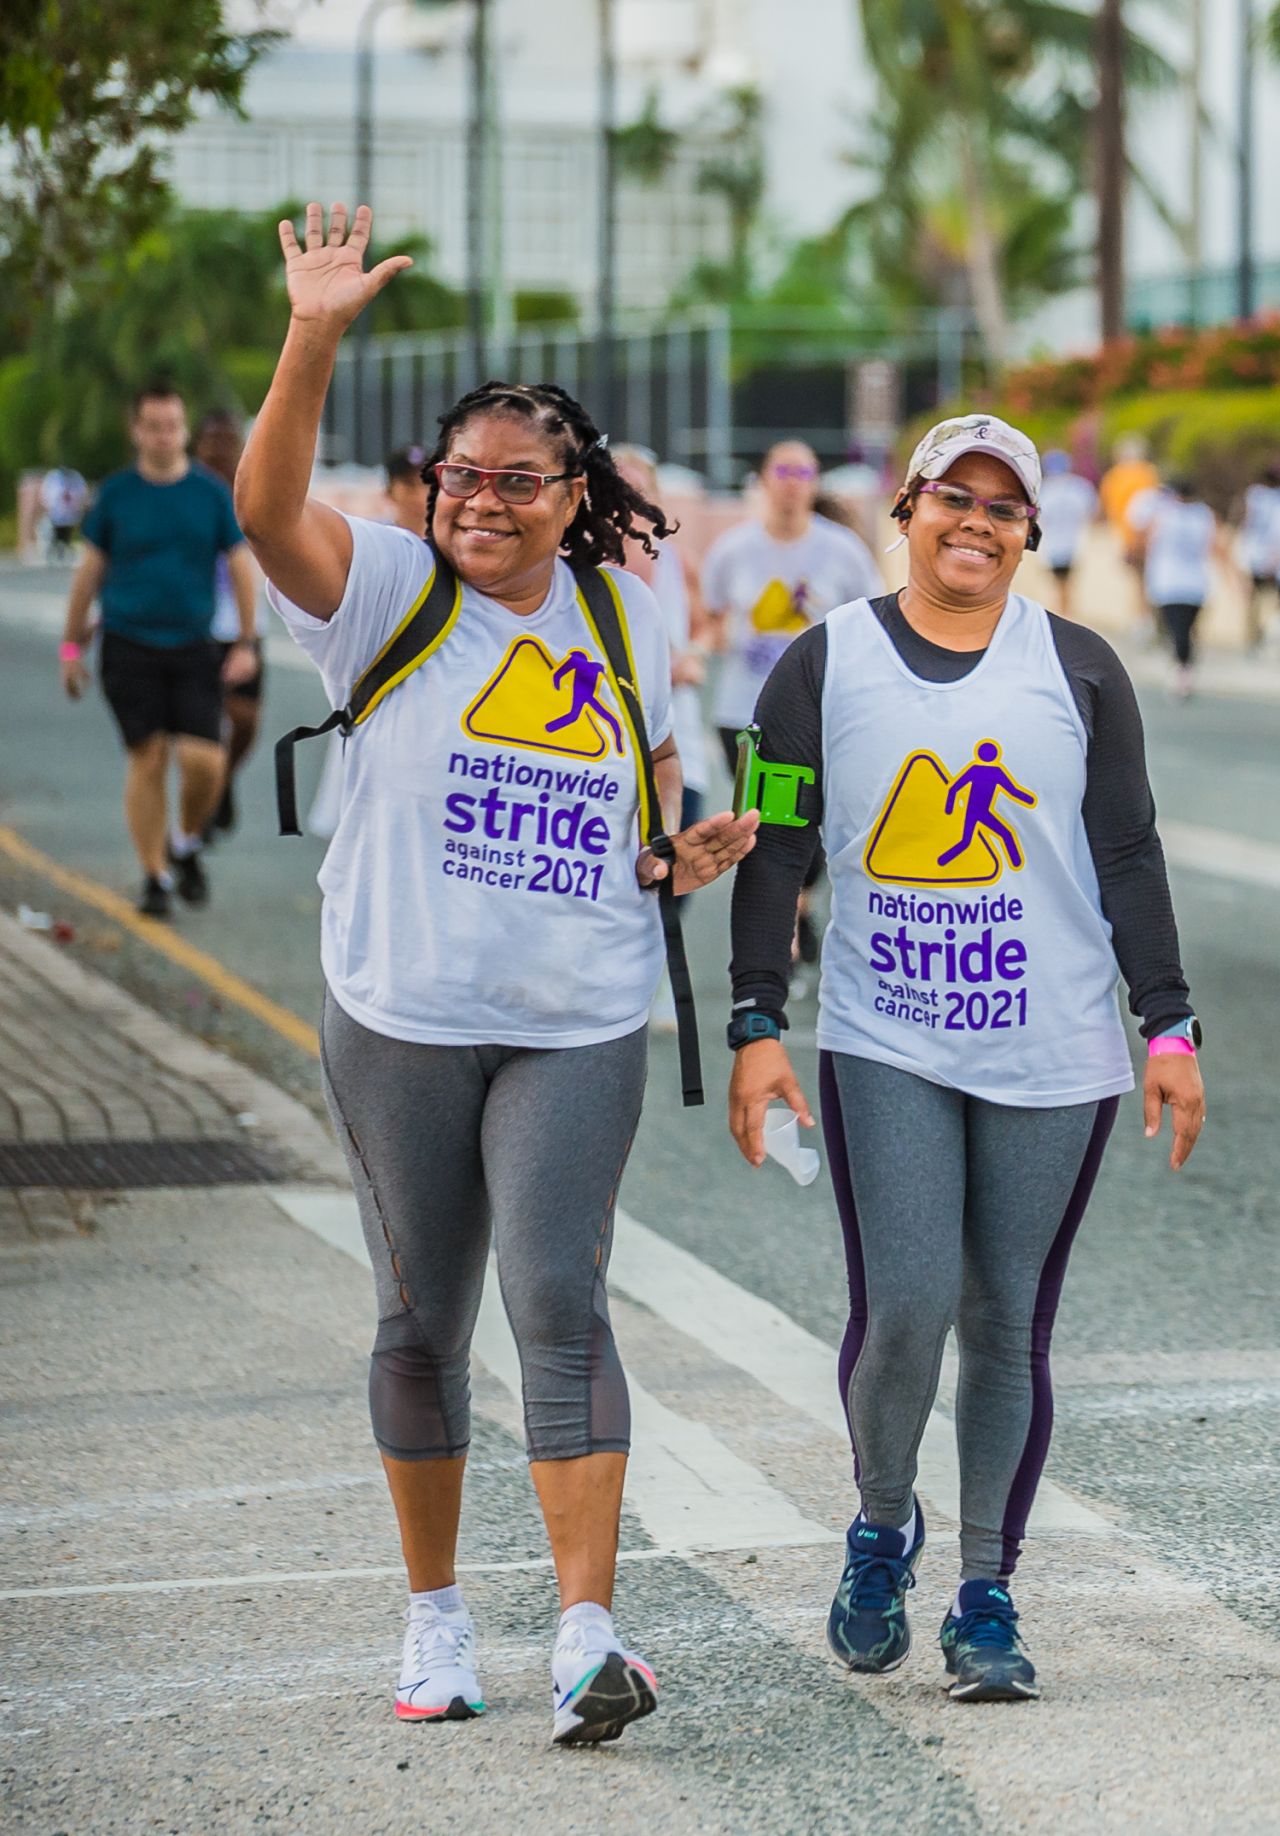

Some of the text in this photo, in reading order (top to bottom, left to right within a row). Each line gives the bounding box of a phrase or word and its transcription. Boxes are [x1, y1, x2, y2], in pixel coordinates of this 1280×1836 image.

[448, 752, 619, 801] nationwide
[443, 787, 611, 855] stride
[445, 839, 526, 867] against
[442, 854, 605, 901] cancer 2021
[868, 892, 1024, 924] nationwide
[869, 926, 1027, 983] stride
[874, 987, 1027, 1031] cancer 2021
